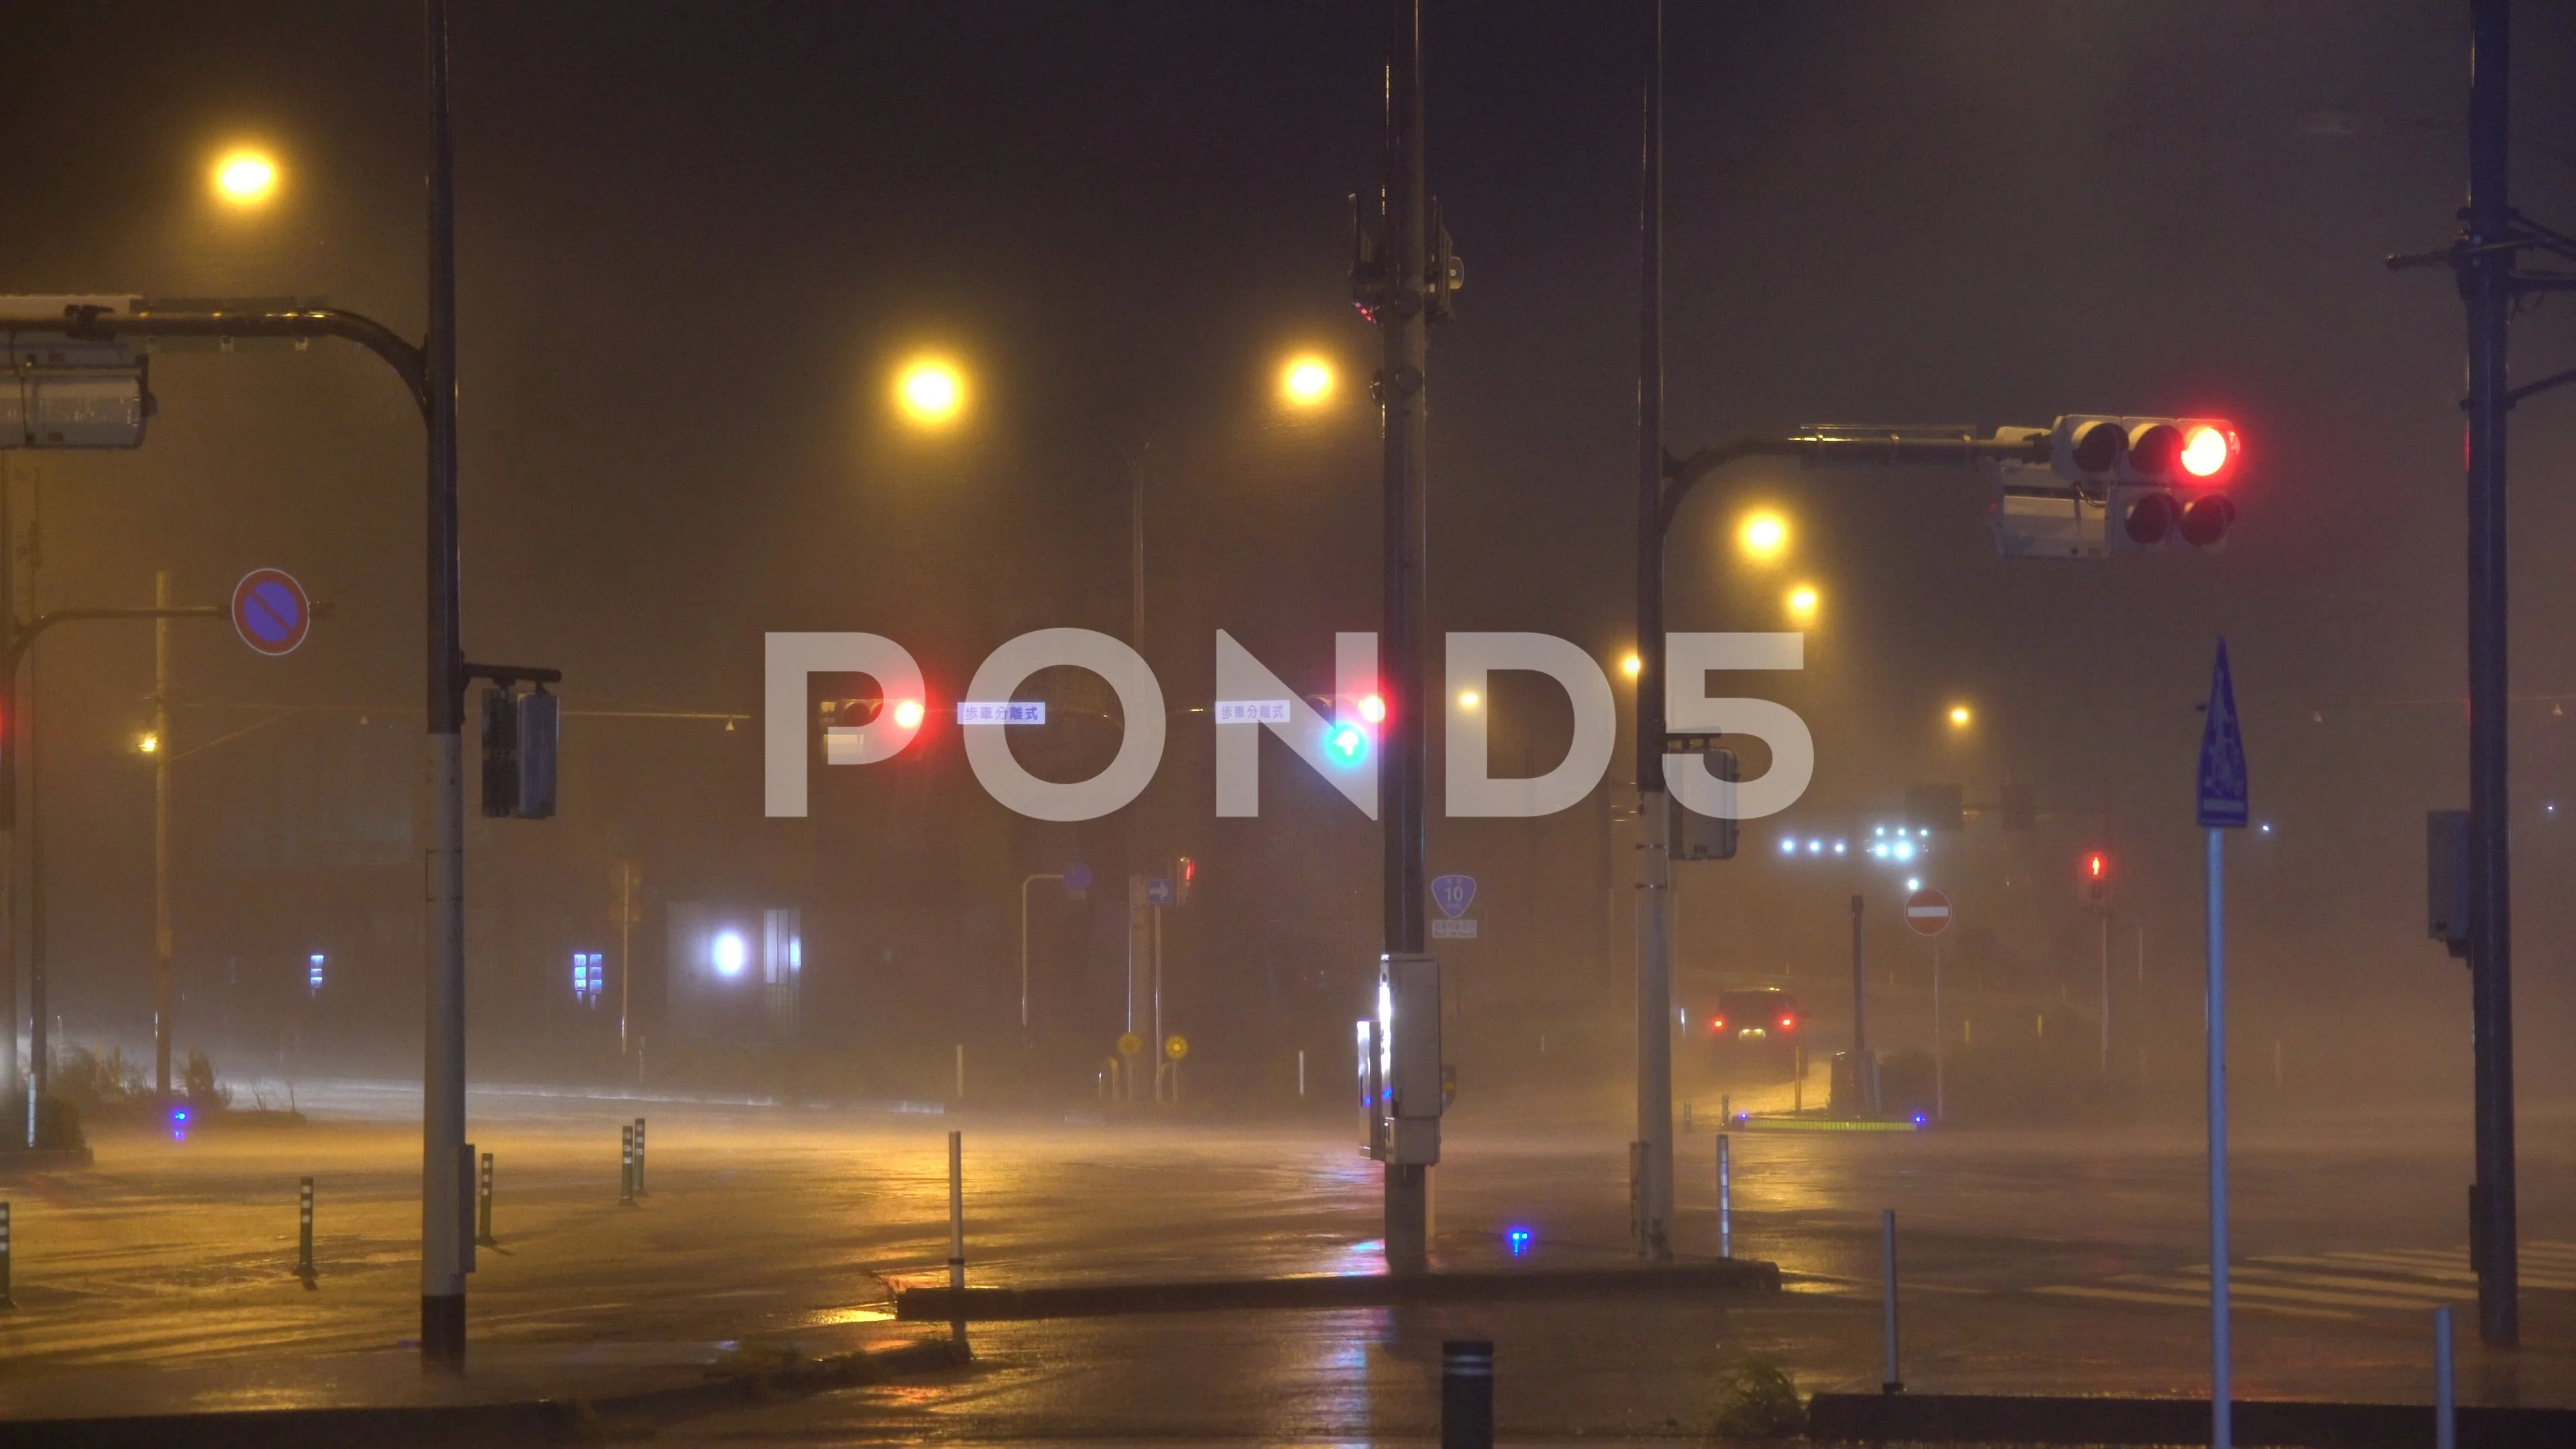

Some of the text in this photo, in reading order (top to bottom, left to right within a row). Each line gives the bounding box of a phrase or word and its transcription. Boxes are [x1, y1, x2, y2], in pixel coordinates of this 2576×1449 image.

[965, 706, 1038, 720] 歩車分離式
[1221, 704, 1284, 719] 歩車分離式
[1445, 886, 1463, 902] 10
